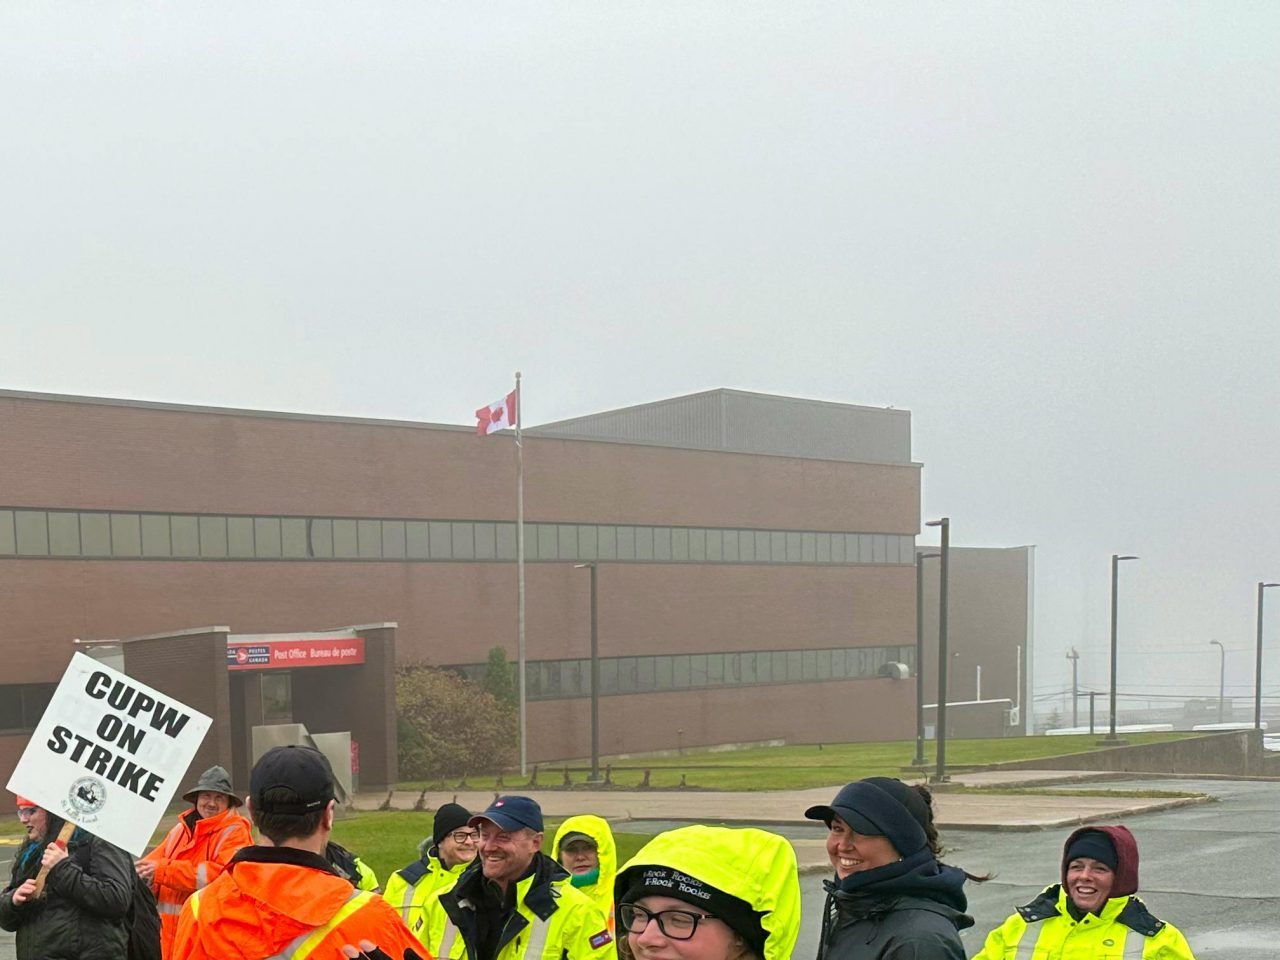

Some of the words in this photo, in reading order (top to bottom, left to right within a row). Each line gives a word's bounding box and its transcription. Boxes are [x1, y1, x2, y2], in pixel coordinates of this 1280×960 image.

[274, 649, 288, 660] Post
[288, 648, 307, 659] Office
[310, 648, 331, 658] Bureau
[331, 647, 340, 657] de
[340, 647, 358, 659] poste
[85, 671, 190, 739] CUPW
[96, 713, 146, 755] ON
[47, 725, 165, 802] STRIKE
